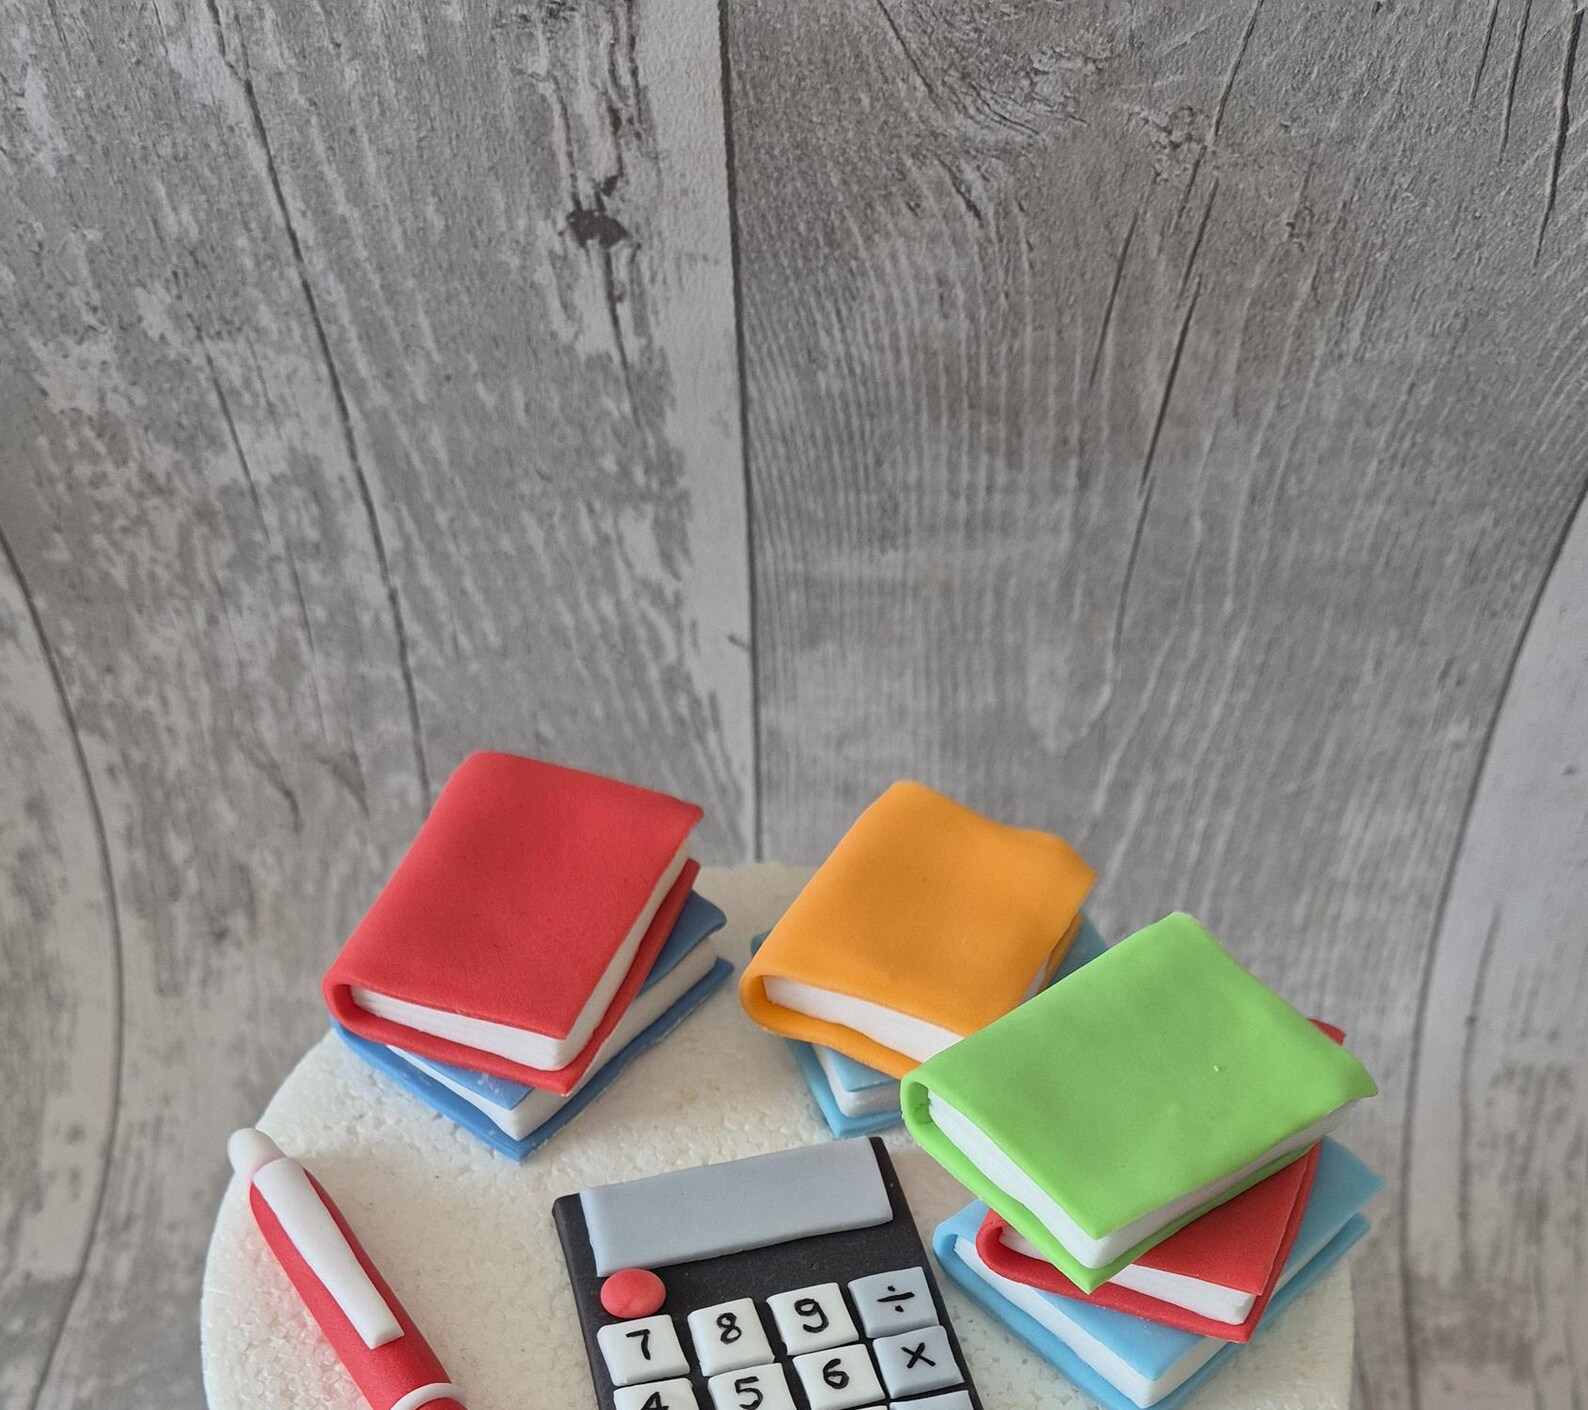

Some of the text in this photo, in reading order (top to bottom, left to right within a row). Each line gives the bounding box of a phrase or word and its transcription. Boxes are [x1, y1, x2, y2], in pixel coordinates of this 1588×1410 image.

[626, 1329, 651, 1361] 7
[716, 1312, 743, 1345] 8
[793, 1297, 830, 1334] 9
[822, 1357, 850, 1390] 6
